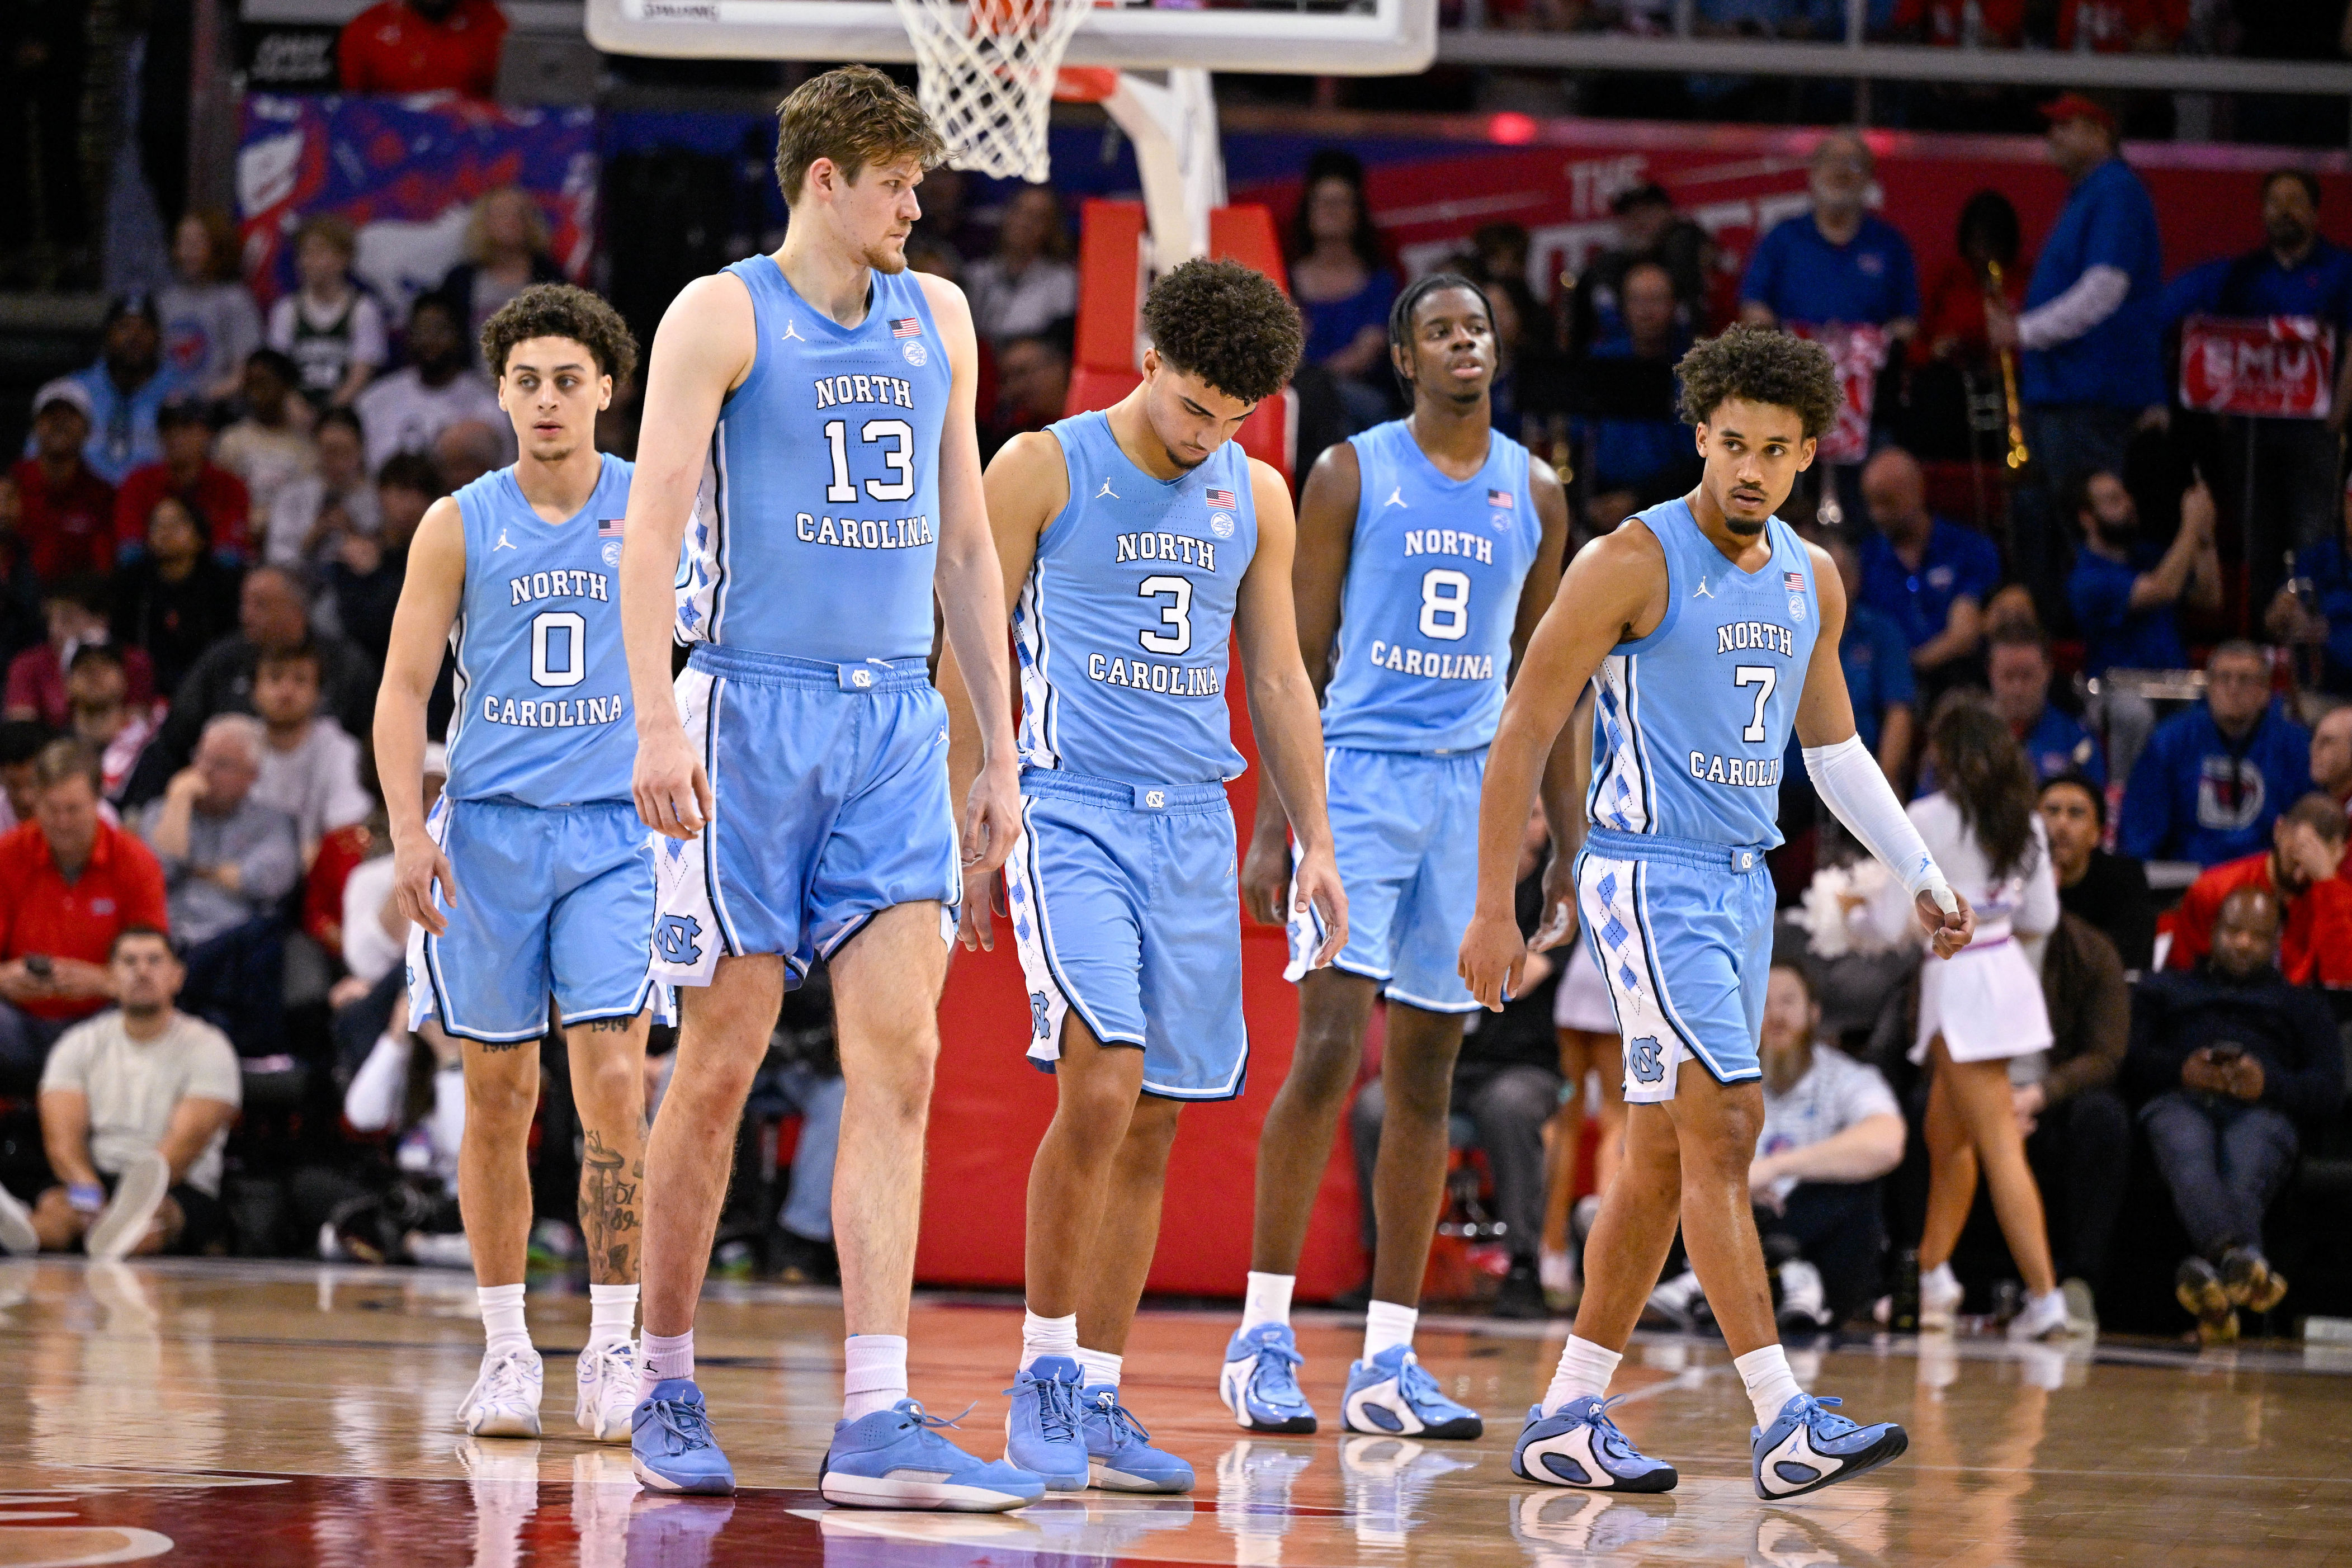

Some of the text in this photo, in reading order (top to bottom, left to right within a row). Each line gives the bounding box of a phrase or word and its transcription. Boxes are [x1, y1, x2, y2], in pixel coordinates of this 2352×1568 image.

[814, 375, 914, 409] NORTH
[824, 419, 915, 503] 13
[796, 512, 933, 549] CAROLINA
[1404, 528, 1493, 565] NORTH
[1116, 532, 1215, 572] NORTH
[510, 569, 608, 606] NORTH
[1419, 568, 1470, 640] 8
[1138, 575, 1193, 655] 3
[531, 611, 586, 687] 0
[1370, 639, 1494, 680] CAROLINA
[1717, 621, 1792, 658] NORTH
[1088, 653, 1220, 696] CAROLINA
[484, 695, 622, 728] CAROLINA
[1734, 665, 1777, 743] 7
